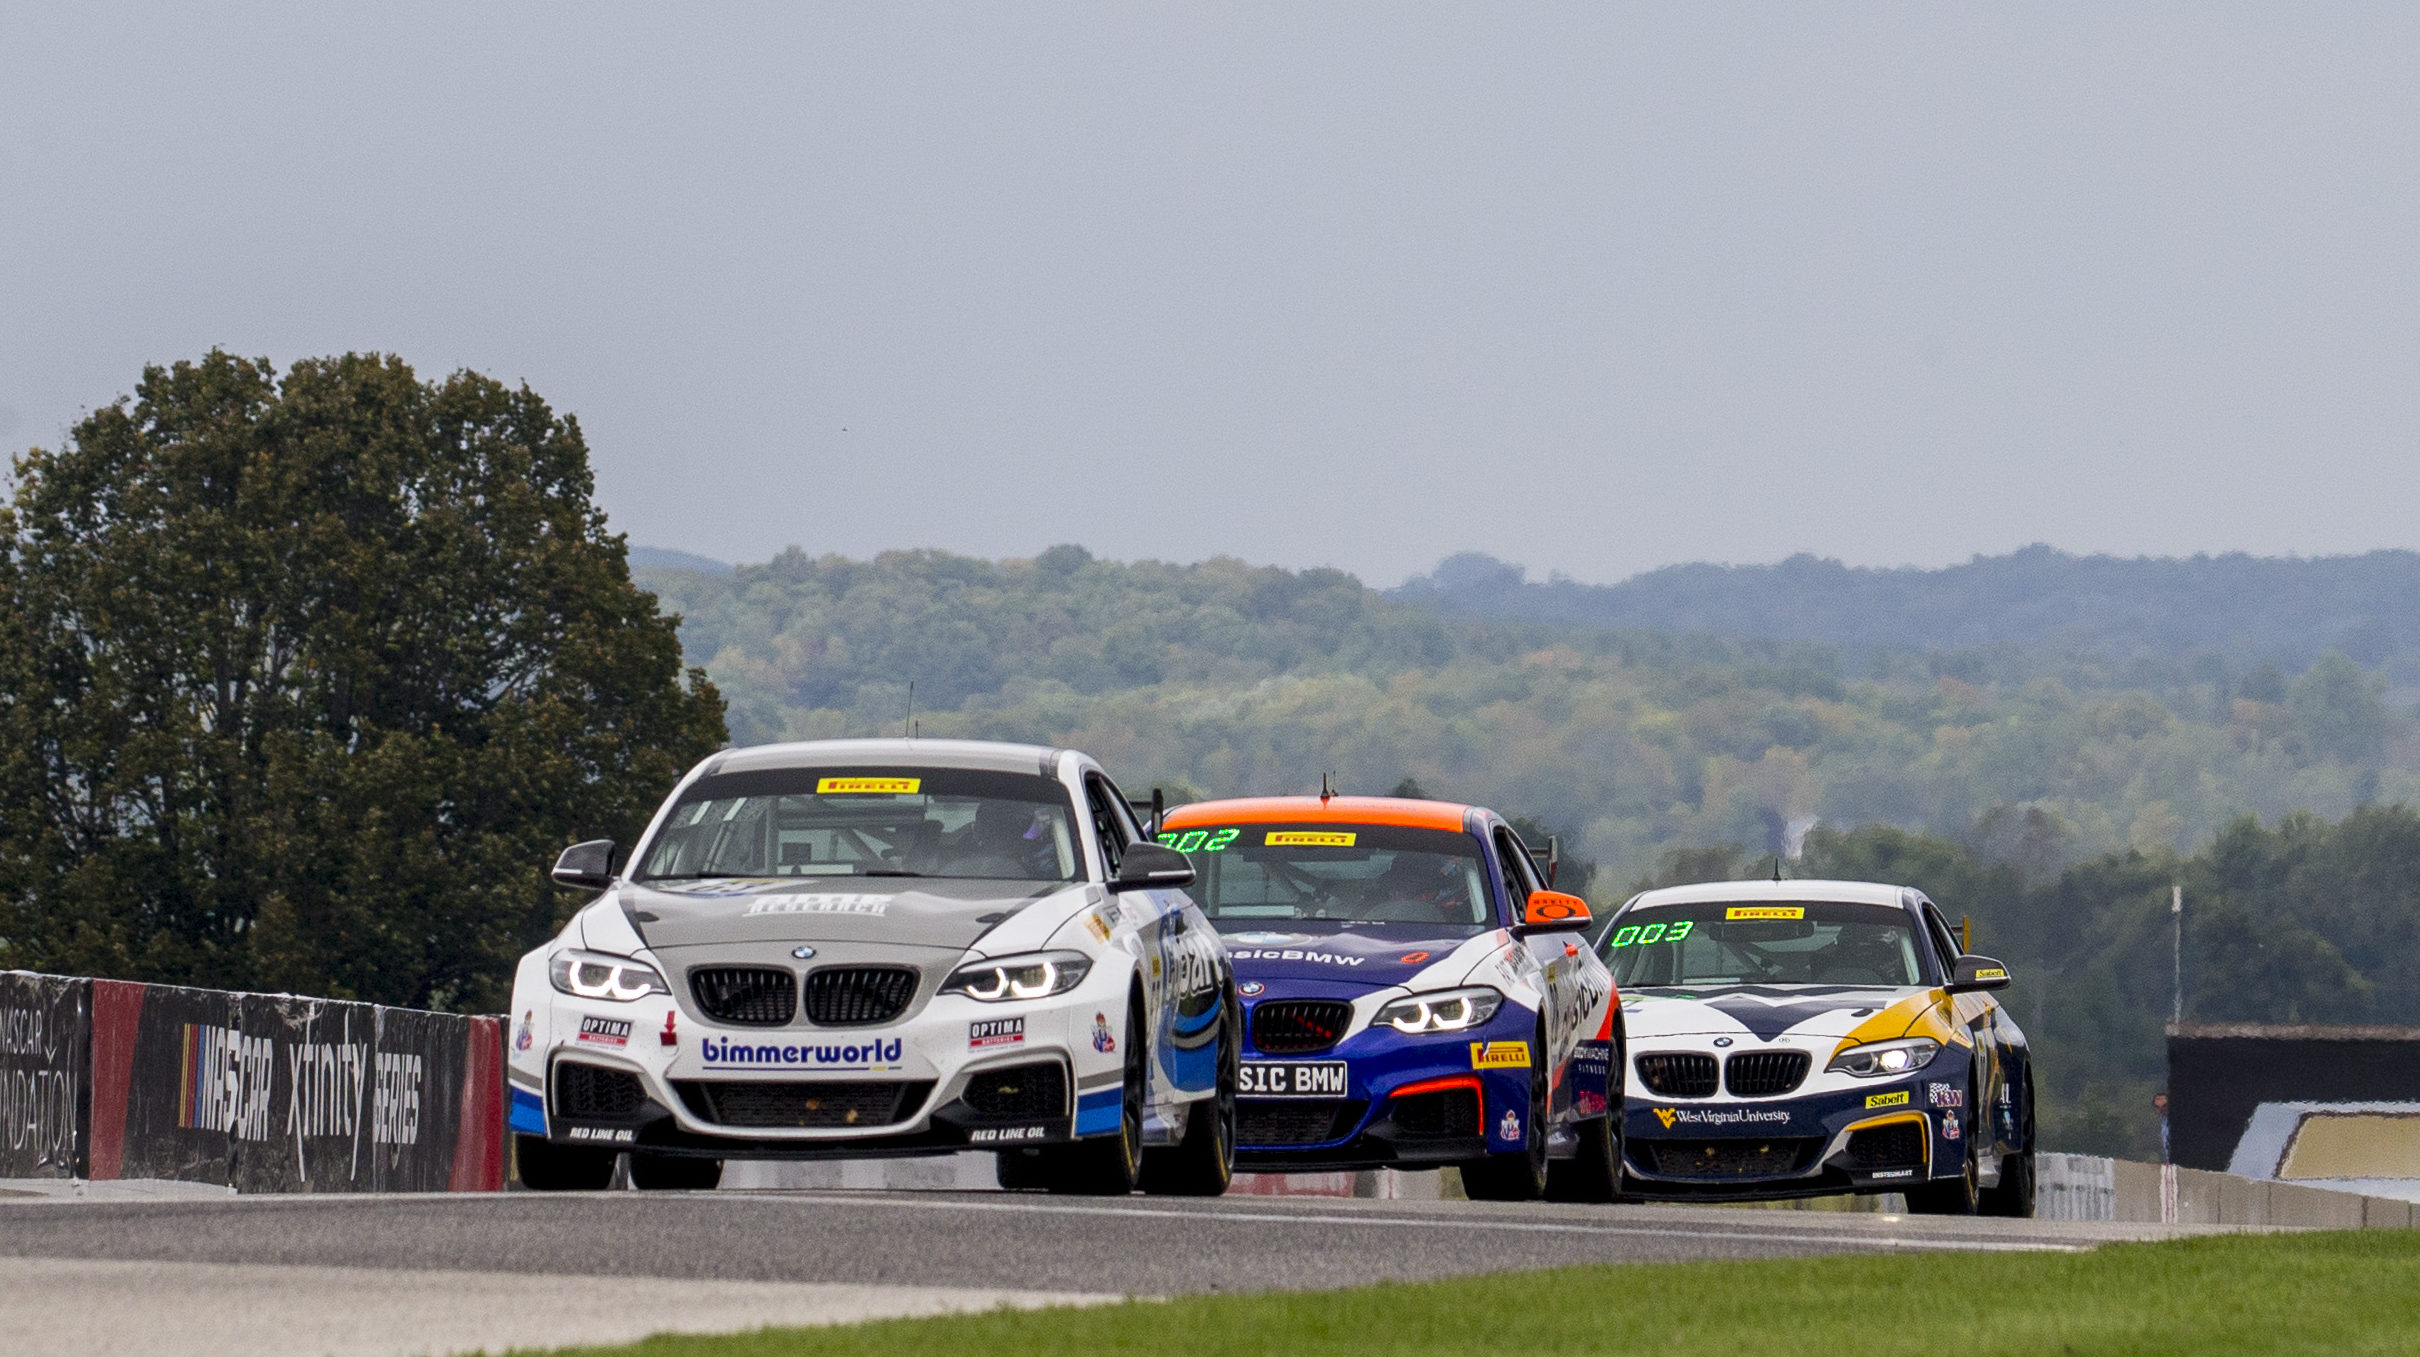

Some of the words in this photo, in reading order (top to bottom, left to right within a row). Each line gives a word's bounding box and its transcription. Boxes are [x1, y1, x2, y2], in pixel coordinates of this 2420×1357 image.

[1611, 921, 1694, 947] 003
[1229, 948, 1365, 967] sicBMW
[583, 1018, 629, 1036] OPTIMA
[972, 1019, 1022, 1037] OPTIMA
[702, 1036, 902, 1063] bimmerworld
[1477, 1047, 1525, 1062] PIRELLI
[201, 1025, 273, 1142] NASCAR
[373, 1052, 422, 1145] SERIES
[1295, 1066, 1344, 1092] BMW
[590, 1128, 614, 1141] LINE
[615, 1129, 633, 1141] OIL
[971, 1129, 997, 1141] RED
[998, 1127, 1026, 1140] LINE
[1027, 1126, 1045, 1139] OIL
